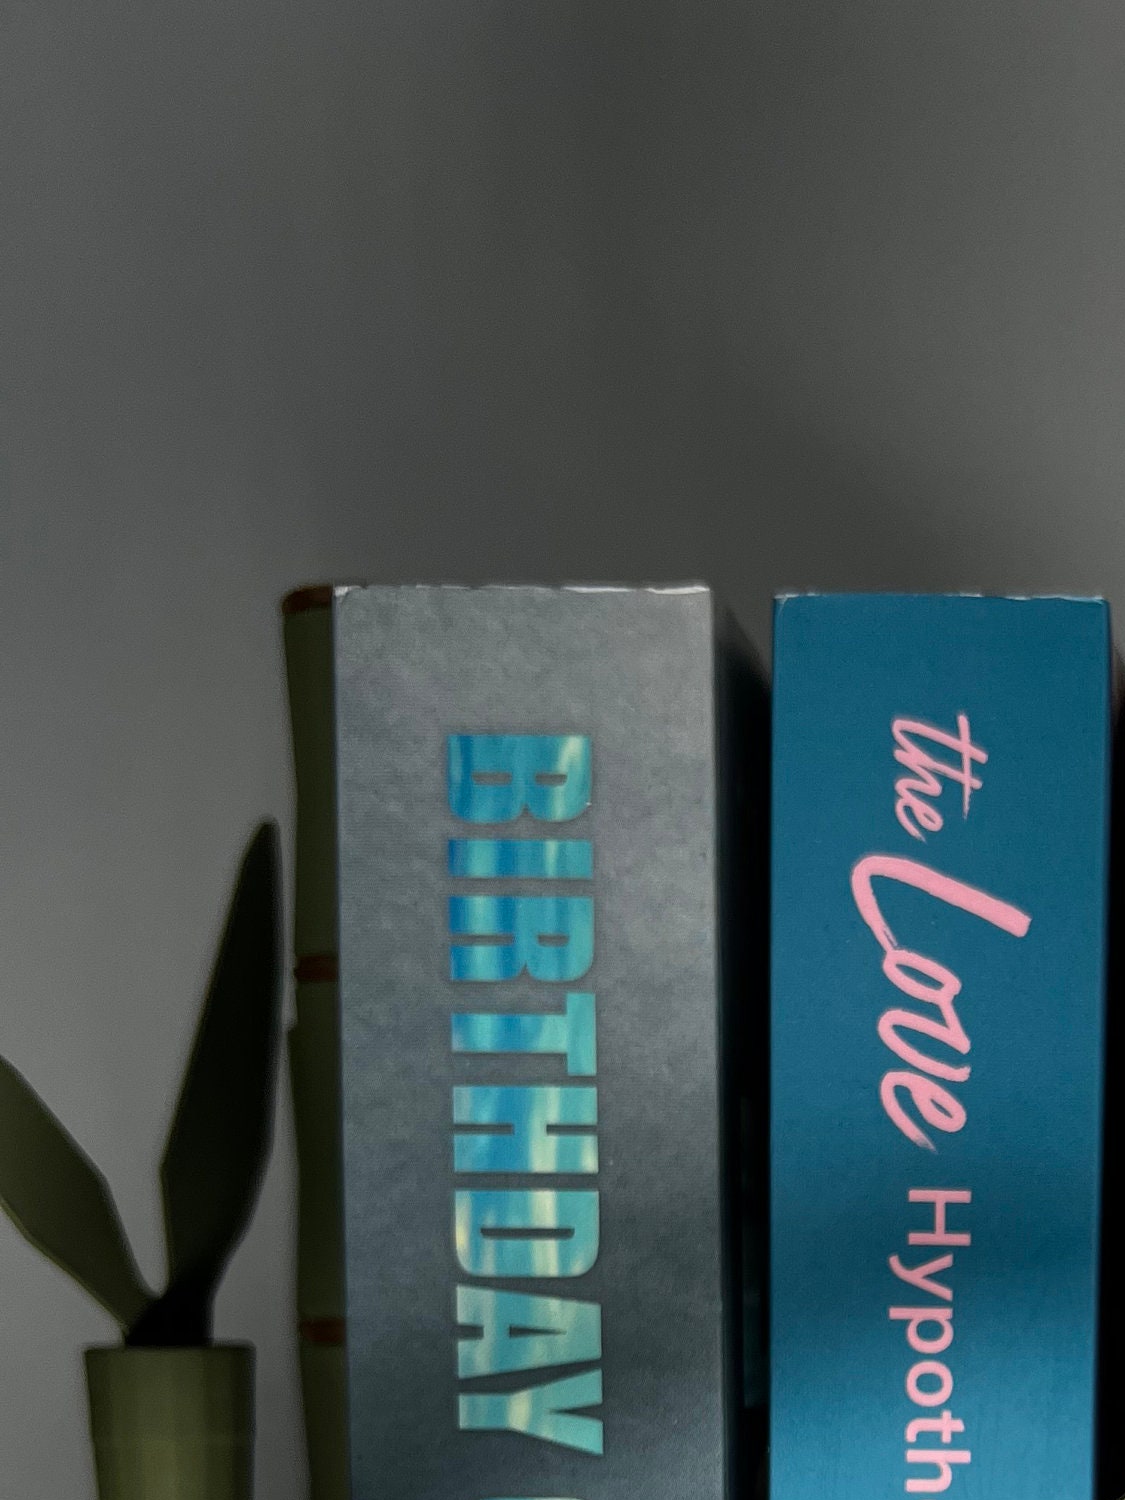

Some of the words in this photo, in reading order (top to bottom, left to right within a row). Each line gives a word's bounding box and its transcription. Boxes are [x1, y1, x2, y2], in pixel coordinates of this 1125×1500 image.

[891, 713, 989, 843] the
[447, 734, 603, 1455] BIRTHDAY
[850, 855, 1032, 1152] Love
